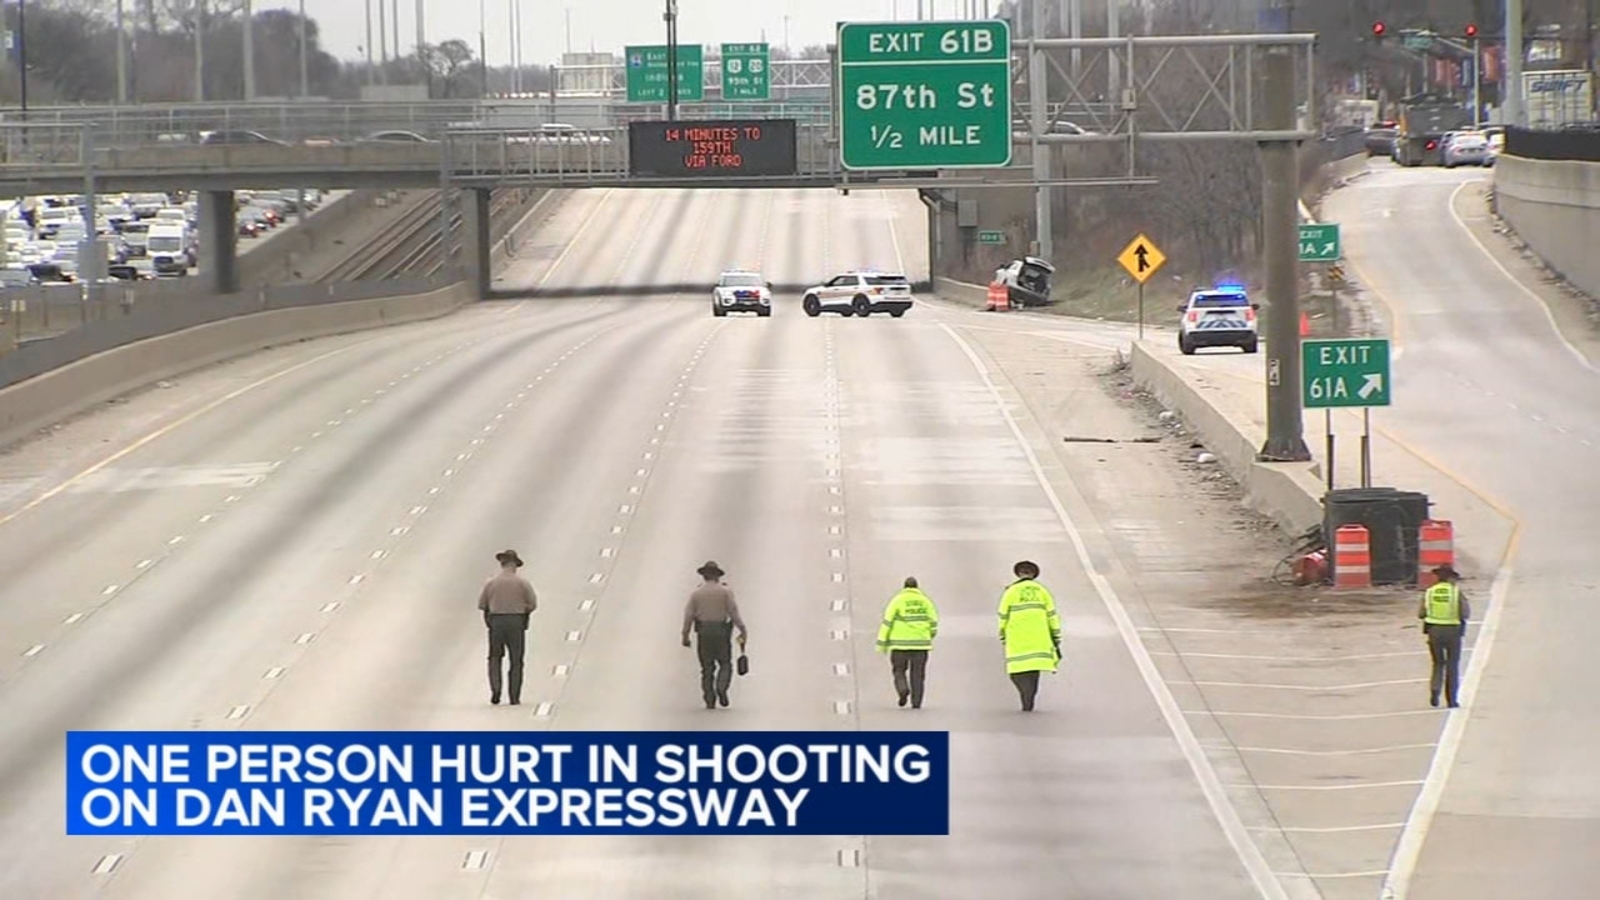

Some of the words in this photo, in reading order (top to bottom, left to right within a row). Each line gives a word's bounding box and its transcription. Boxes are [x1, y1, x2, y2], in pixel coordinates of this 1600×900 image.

[869, 33, 924, 53] EXIT
[940, 29, 993, 53] 61B
[1531, 79, 1587, 92] SWIFT
[857, 84, 936, 109] 87th
[957, 82, 994, 108] St
[665, 129, 680, 142] 14
[684, 127, 738, 141] MINUTES
[743, 127, 761, 140] TO
[919, 125, 981, 145] MILE
[693, 142, 732, 154] 159TH
[684, 155, 706, 168] VIA
[711, 154, 742, 167] FORD
[1299, 230, 1323, 239] EXIT
[1298, 243, 1316, 254] 1A
[1320, 346, 1371, 365] EXIT
[1309, 377, 1348, 399] 61A
